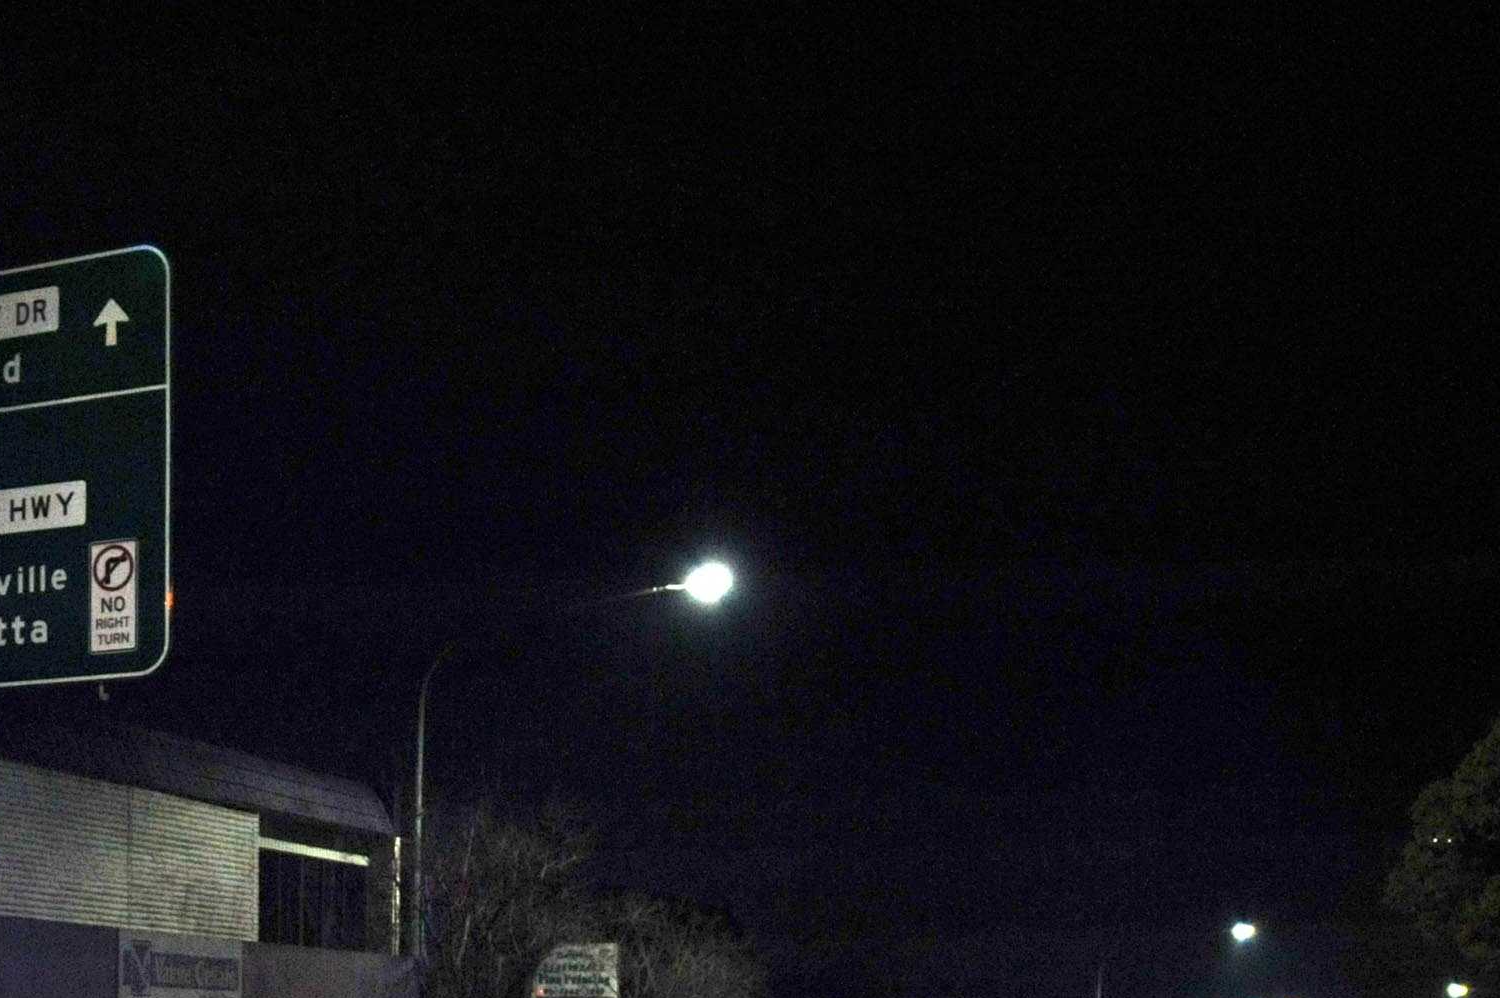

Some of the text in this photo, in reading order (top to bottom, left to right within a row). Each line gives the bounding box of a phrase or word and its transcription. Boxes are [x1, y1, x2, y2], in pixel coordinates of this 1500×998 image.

[15, 299, 48, 327] DR
[9, 492, 76, 523] HWY
[101, 597, 126, 613] NO
[95, 615, 131, 630] RIGHT
[97, 631, 130, 646] TURN
